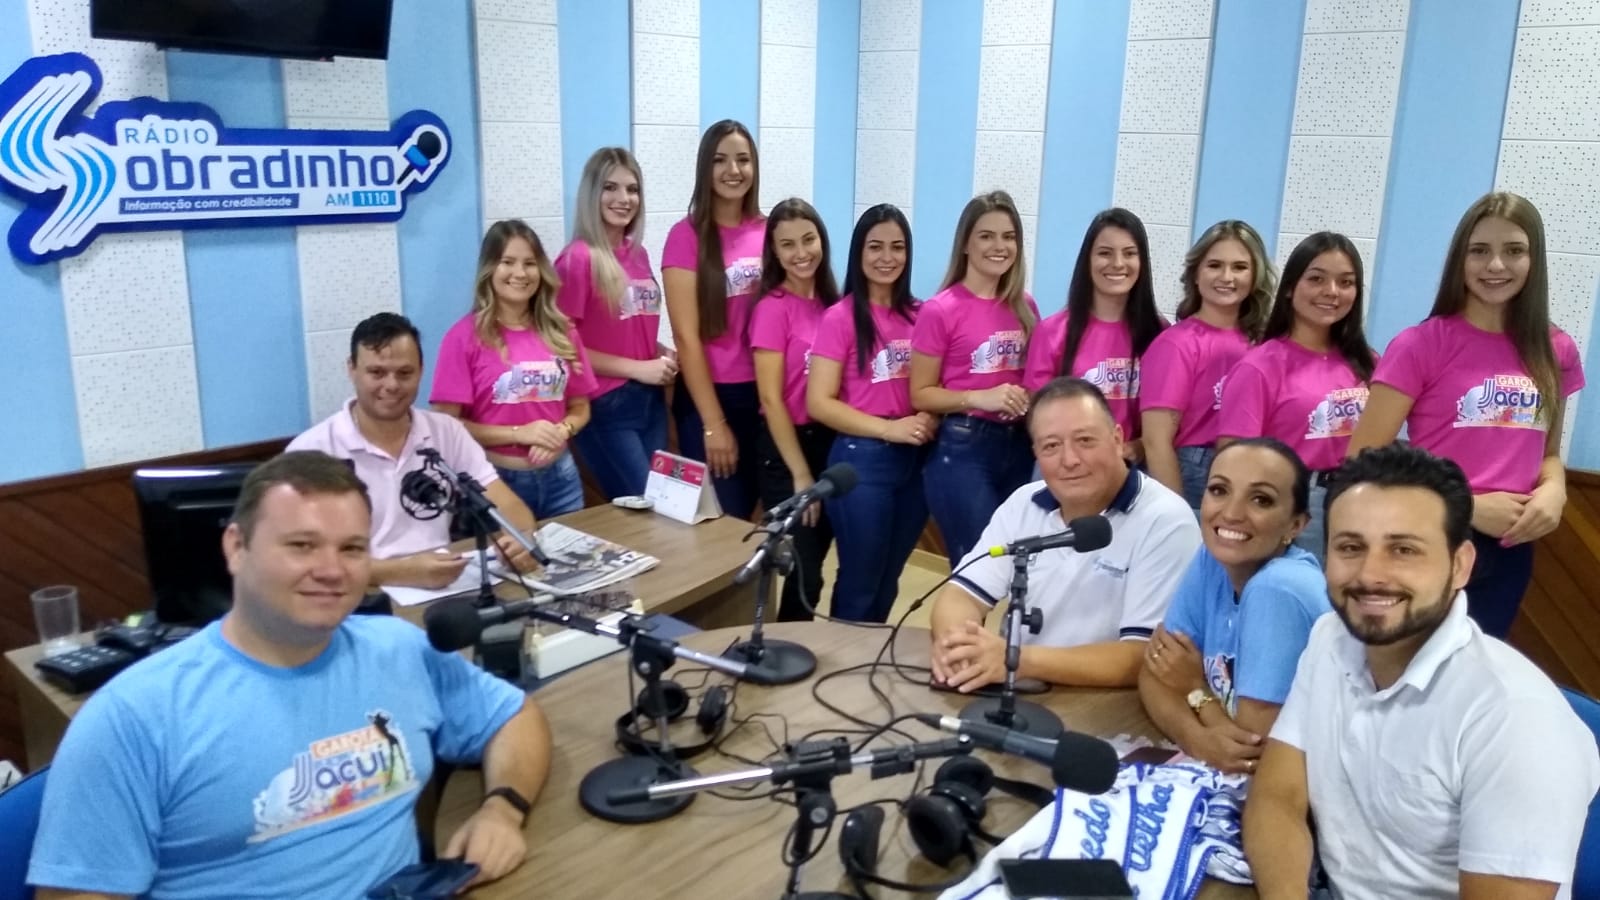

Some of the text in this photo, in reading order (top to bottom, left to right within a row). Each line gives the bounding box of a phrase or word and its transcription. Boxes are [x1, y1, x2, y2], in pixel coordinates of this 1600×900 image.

[124, 123, 209, 144] RÁDIO
[124, 196, 292, 212] Informação com credibilidade
[325, 192, 389, 206] AM 1110
[1498, 376, 1533, 387] GAROT
[1073, 798, 1111, 860] edo
